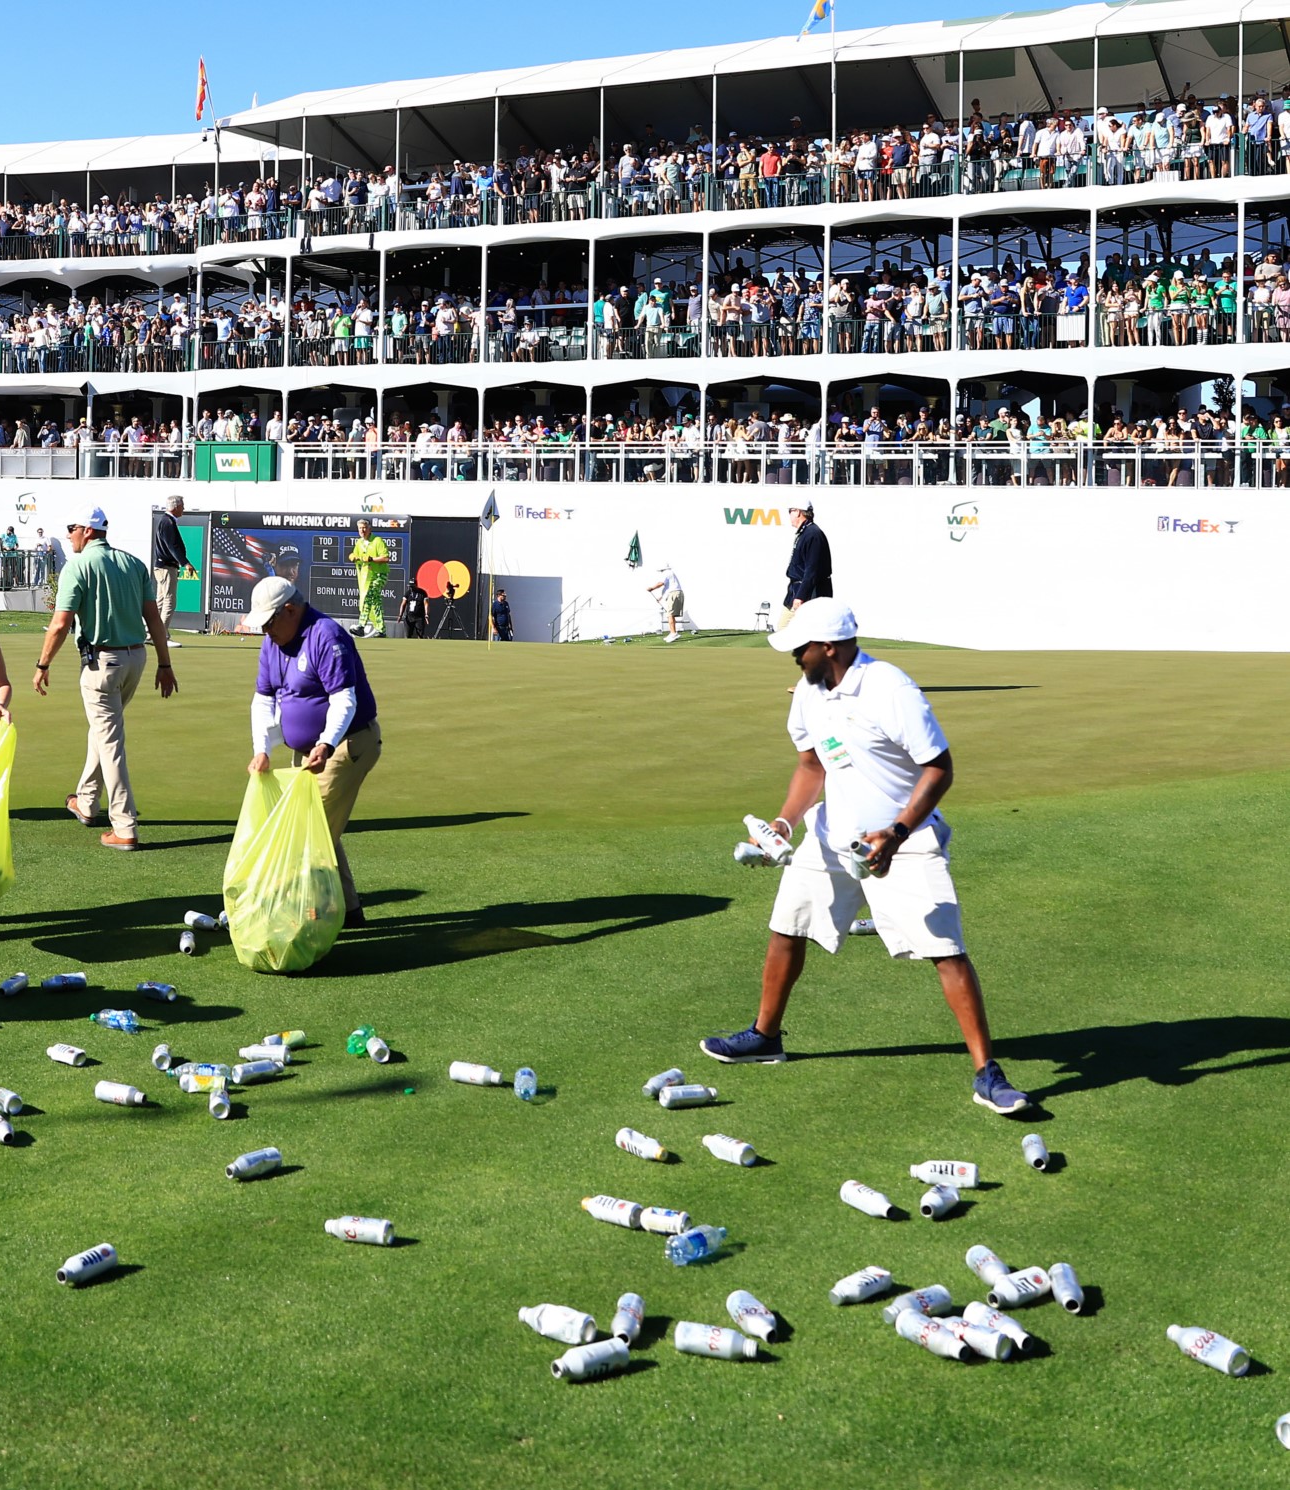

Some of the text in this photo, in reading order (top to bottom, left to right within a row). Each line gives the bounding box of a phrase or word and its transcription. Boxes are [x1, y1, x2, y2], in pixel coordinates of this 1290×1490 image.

[220, 458, 245, 468] WM
[15, 503, 37, 511] WM
[360, 504, 385, 513] WM
[526, 507, 561, 520] FedEx
[723, 507, 782, 526] WM
[262, 515, 351, 528] WM PHOENIX OPEN
[946, 515, 979, 525] WM
[1172, 518, 1220, 533] FedEx
[318, 536, 333, 546] TOD
[322, 549, 329, 560] E
[331, 568, 357, 577] DID YOU
[214, 585, 234, 596] SAM
[316, 586, 336, 595] BORN
[337, 587, 346, 596] IN
[213, 597, 244, 610] RYDER
